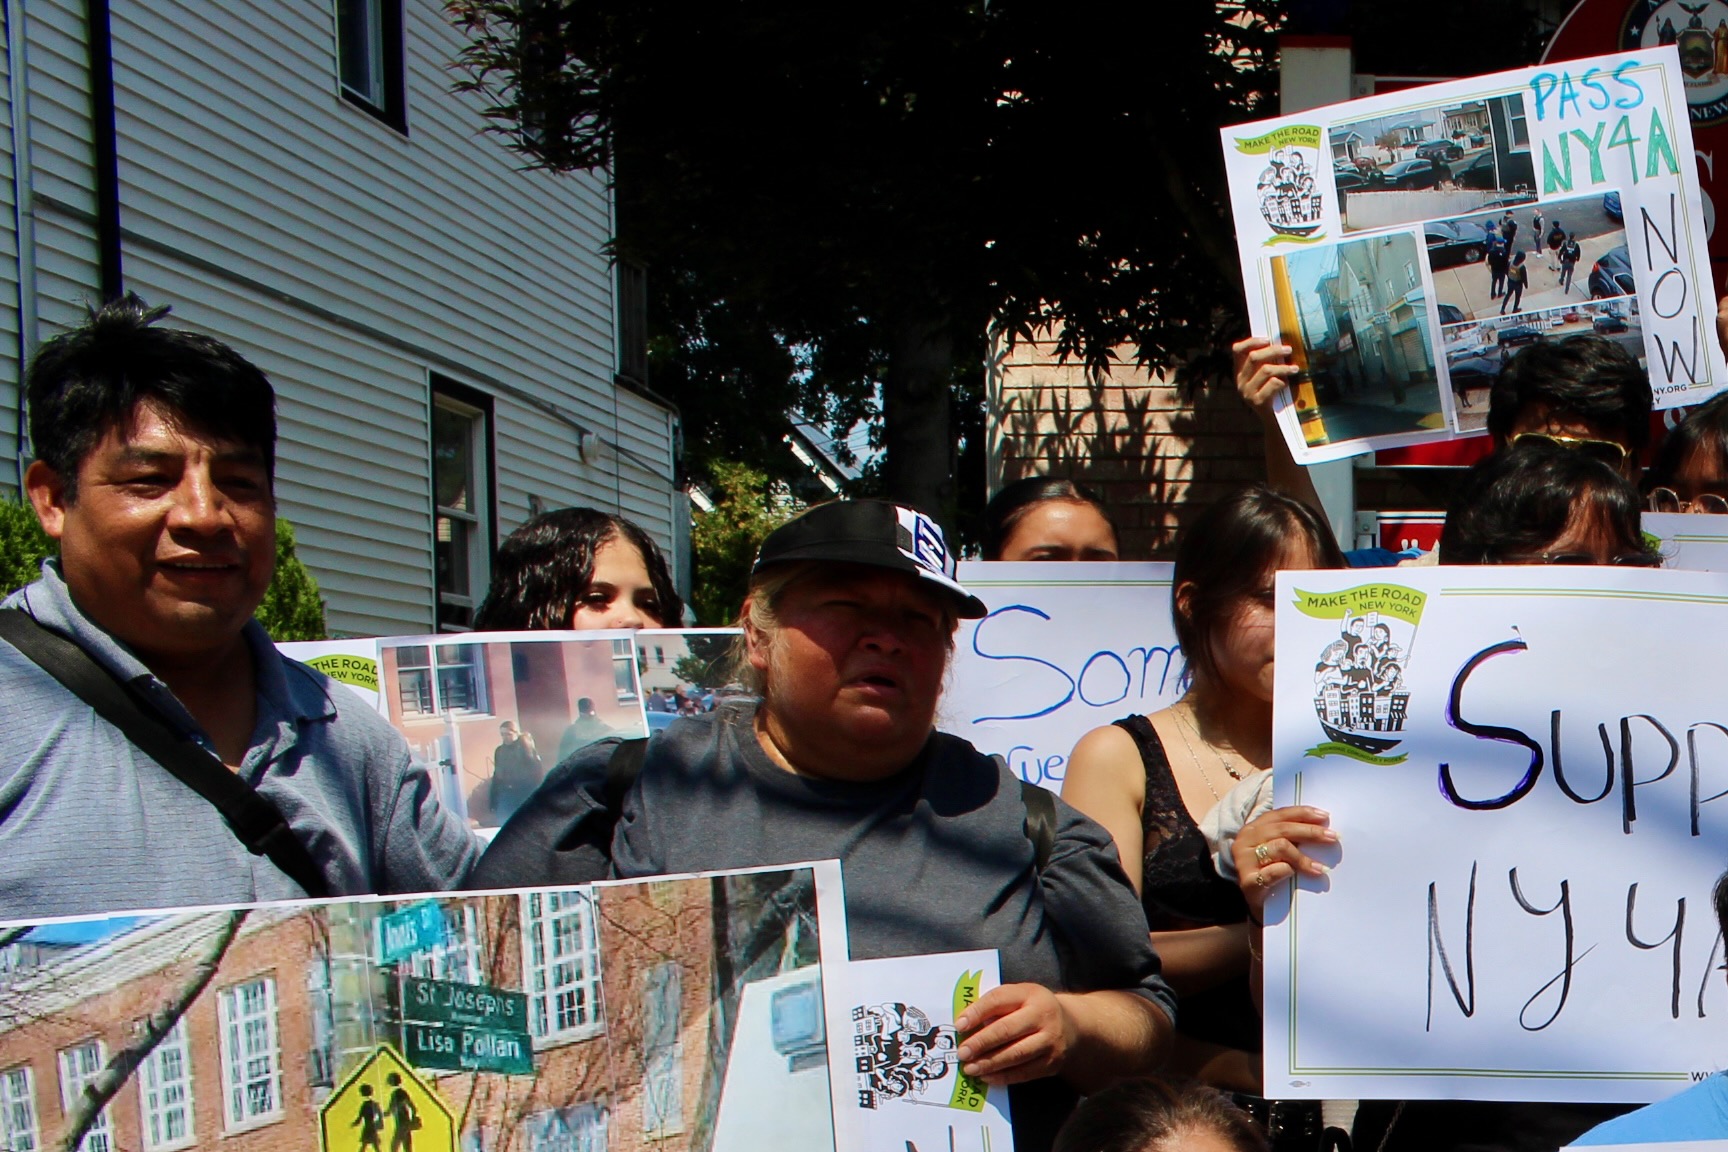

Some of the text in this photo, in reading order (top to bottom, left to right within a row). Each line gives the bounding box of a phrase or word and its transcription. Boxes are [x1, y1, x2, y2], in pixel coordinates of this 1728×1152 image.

[1529, 60, 1645, 122] PASS
[1690, 103, 1728, 120] NEW
[1244, 127, 1320, 149] MAKE THE ROAD
[1279, 136, 1318, 146] NEW YORK
[1307, 587, 1422, 608] MAKE THE ROAD
[1359, 600, 1417, 618] NEW YORK
[351, 671, 379, 687] YORK
[417, 1029, 454, 1054] Lisa
